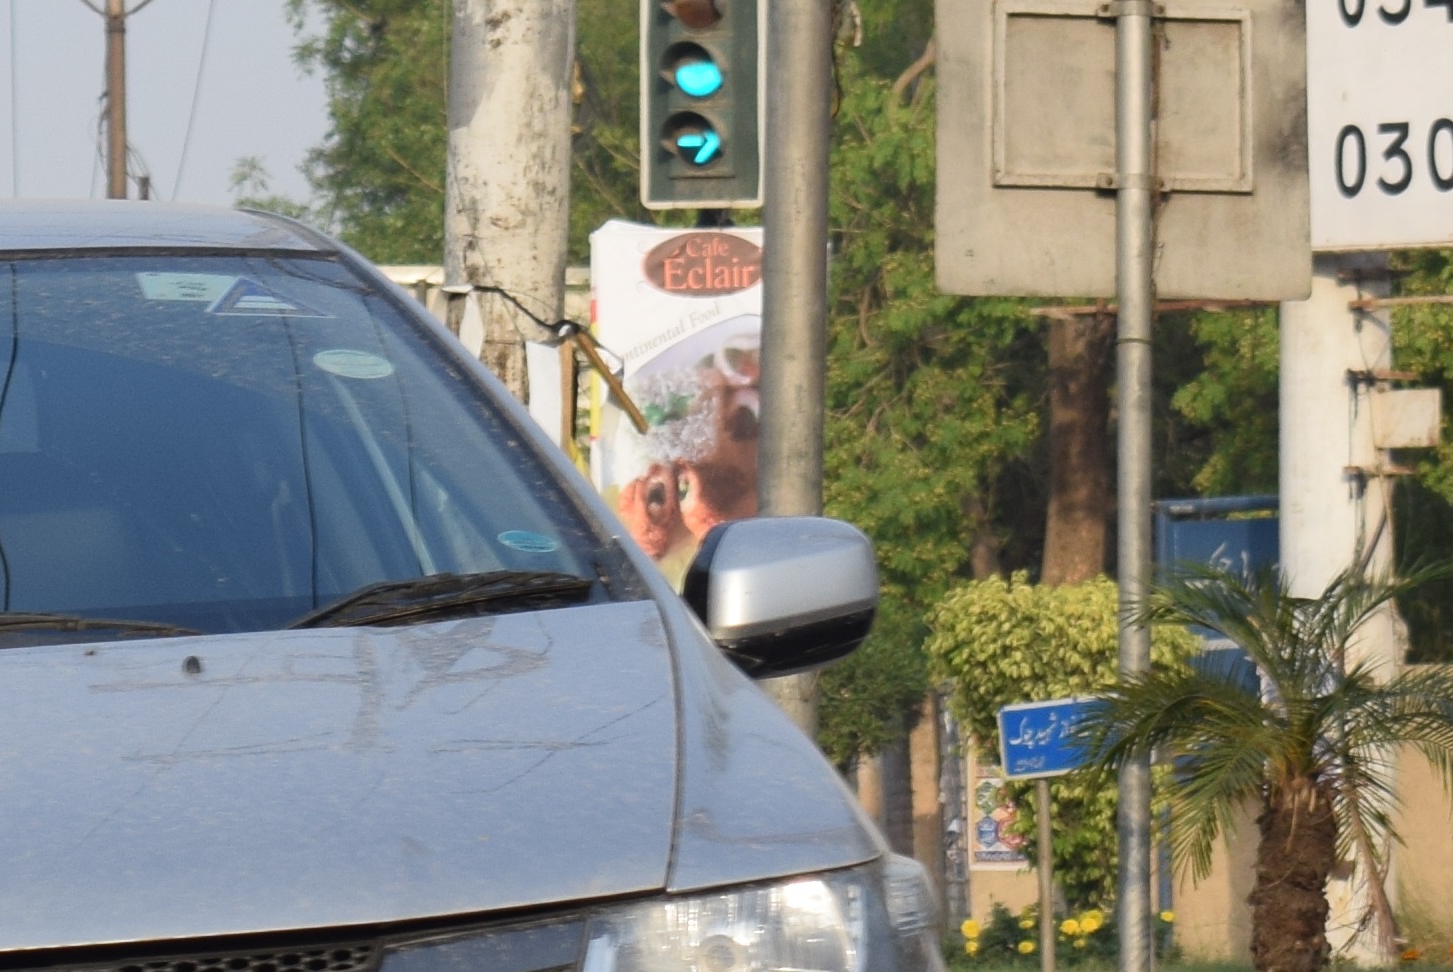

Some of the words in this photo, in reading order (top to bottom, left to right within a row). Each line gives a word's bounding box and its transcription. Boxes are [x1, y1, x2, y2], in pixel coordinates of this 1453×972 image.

[1335, 118, 1453, 199] 030
[686, 238, 730, 257] Cafe
[622, 319, 686, 360] ntinental
[688, 301, 721, 328] Food
